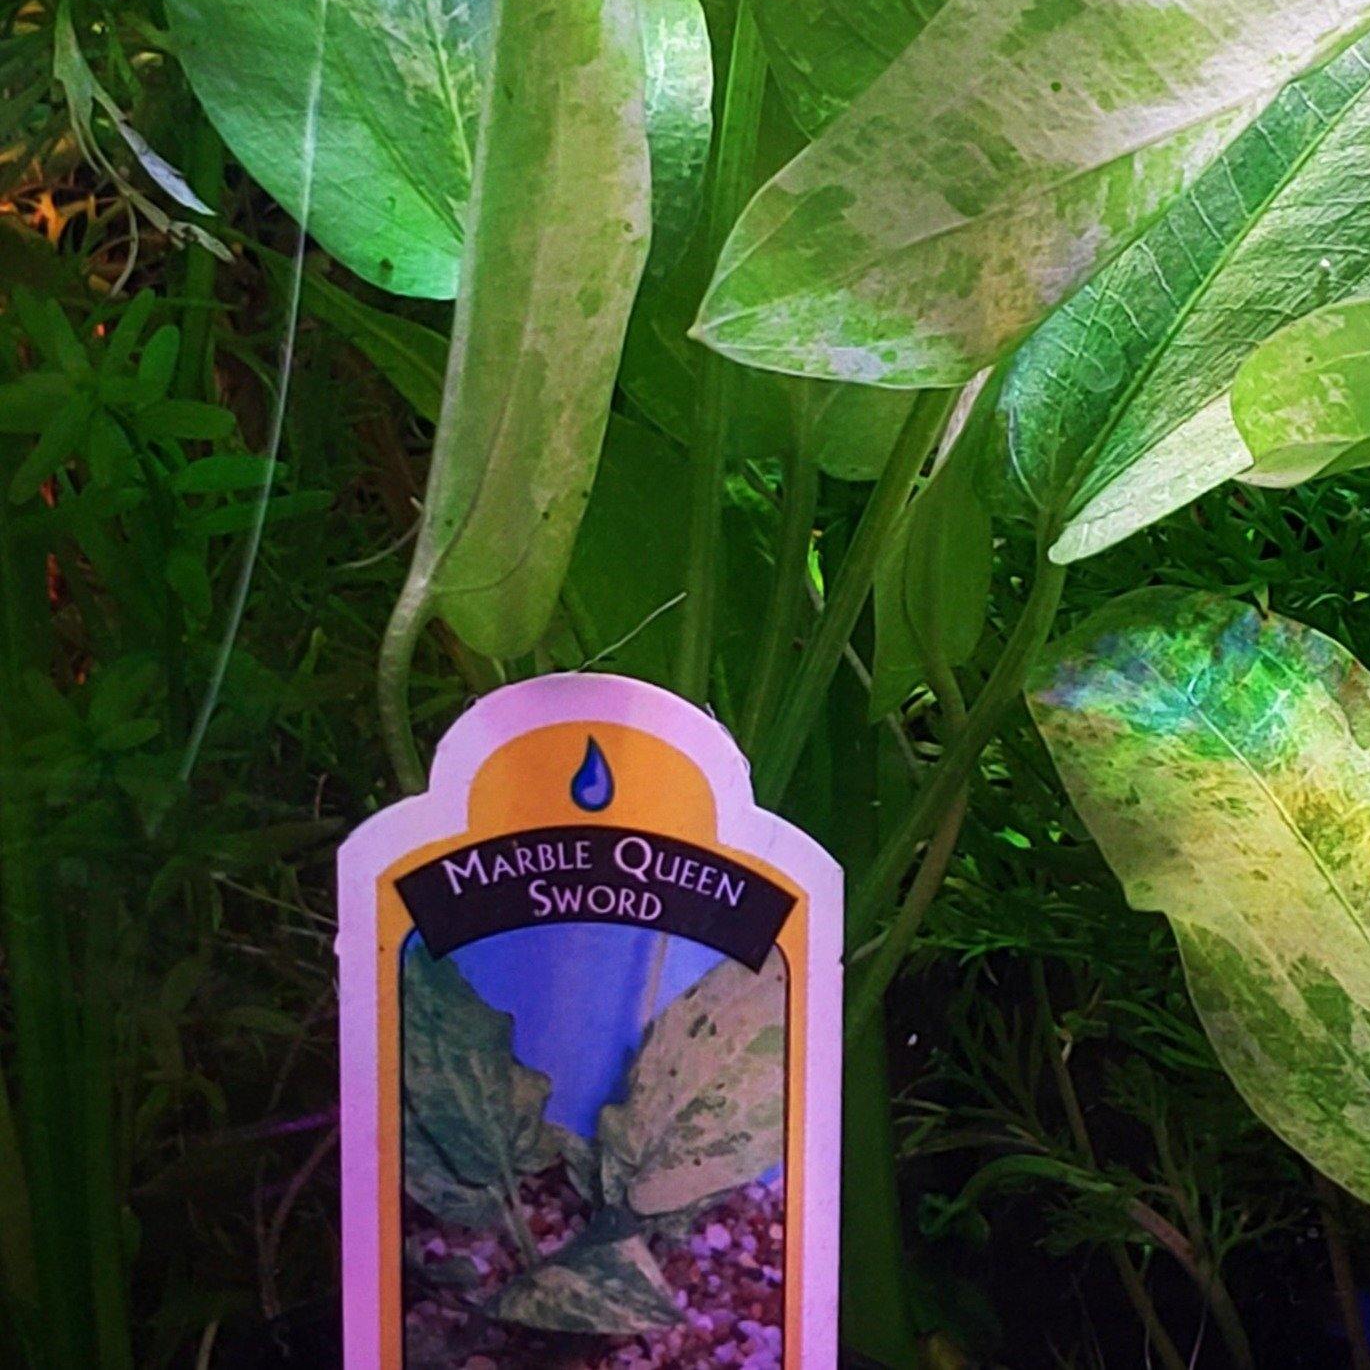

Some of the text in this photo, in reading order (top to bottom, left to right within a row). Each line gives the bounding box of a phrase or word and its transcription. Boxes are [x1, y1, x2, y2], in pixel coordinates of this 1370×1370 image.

[442, 836, 746, 907] MARBLE QUEEN
[527, 879, 662, 921] SWORD
